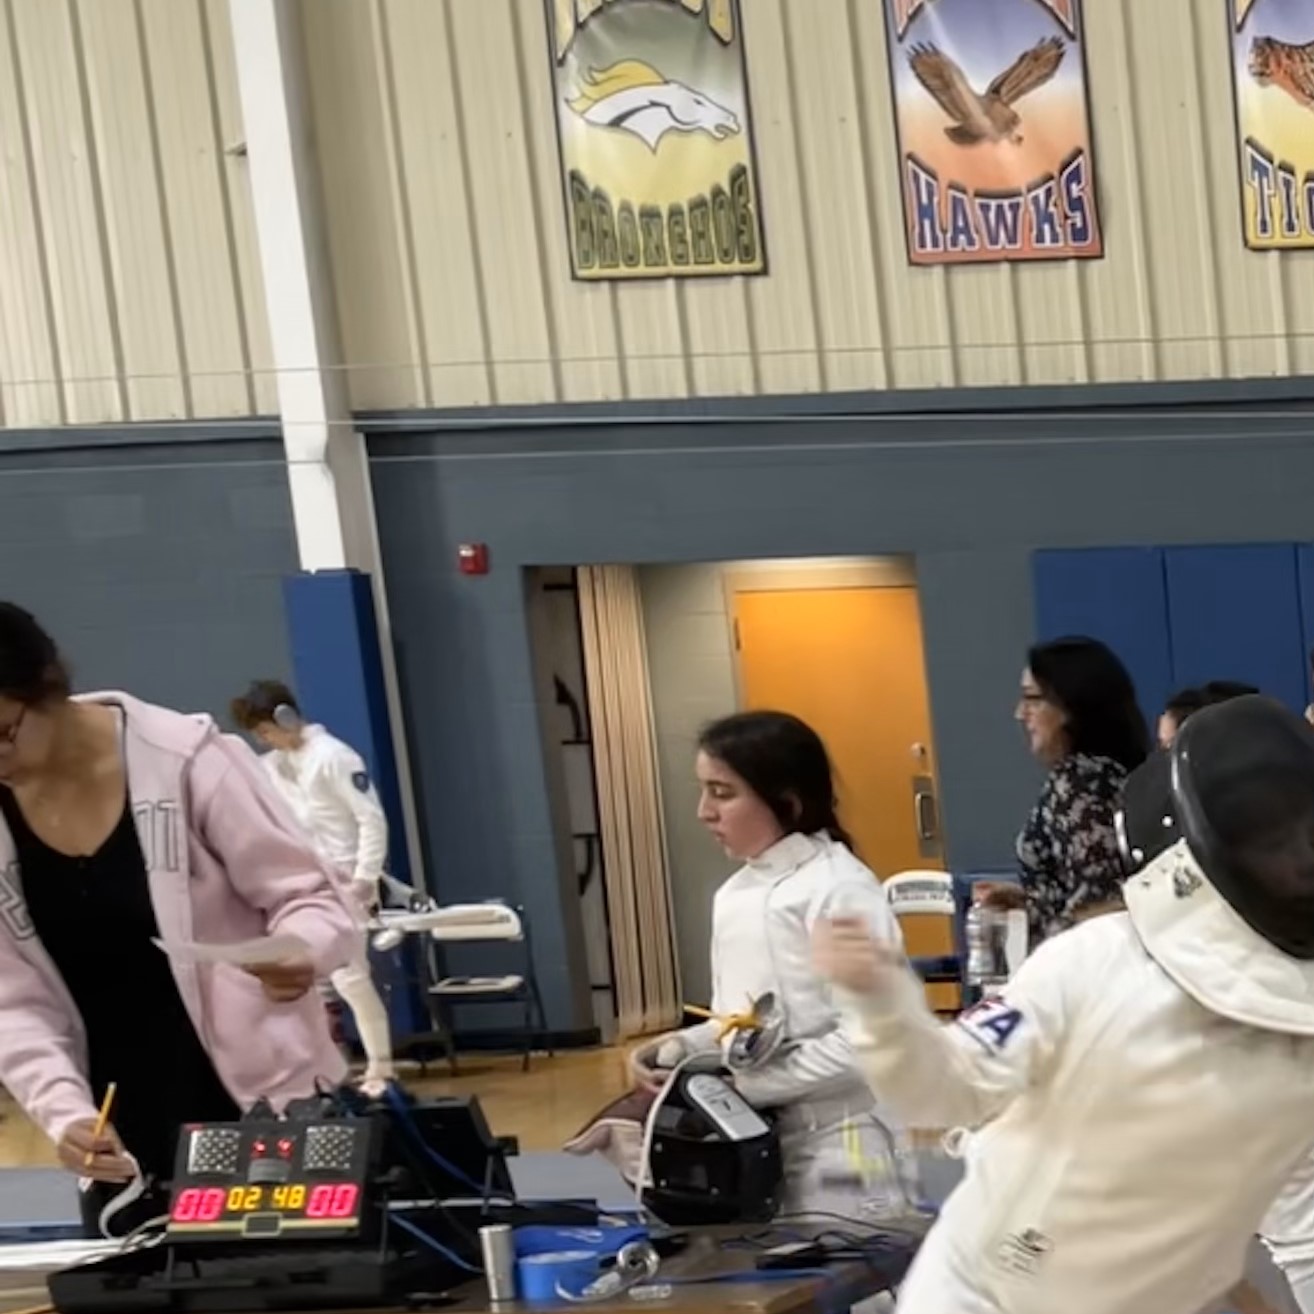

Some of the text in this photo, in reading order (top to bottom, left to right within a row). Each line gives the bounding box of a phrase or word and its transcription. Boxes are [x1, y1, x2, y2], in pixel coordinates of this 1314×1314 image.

[569, 164, 756, 269] BRONCHOS
[906, 150, 1092, 252] HAWKS
[172, 1183, 358, 1221] 00 02 48 00
